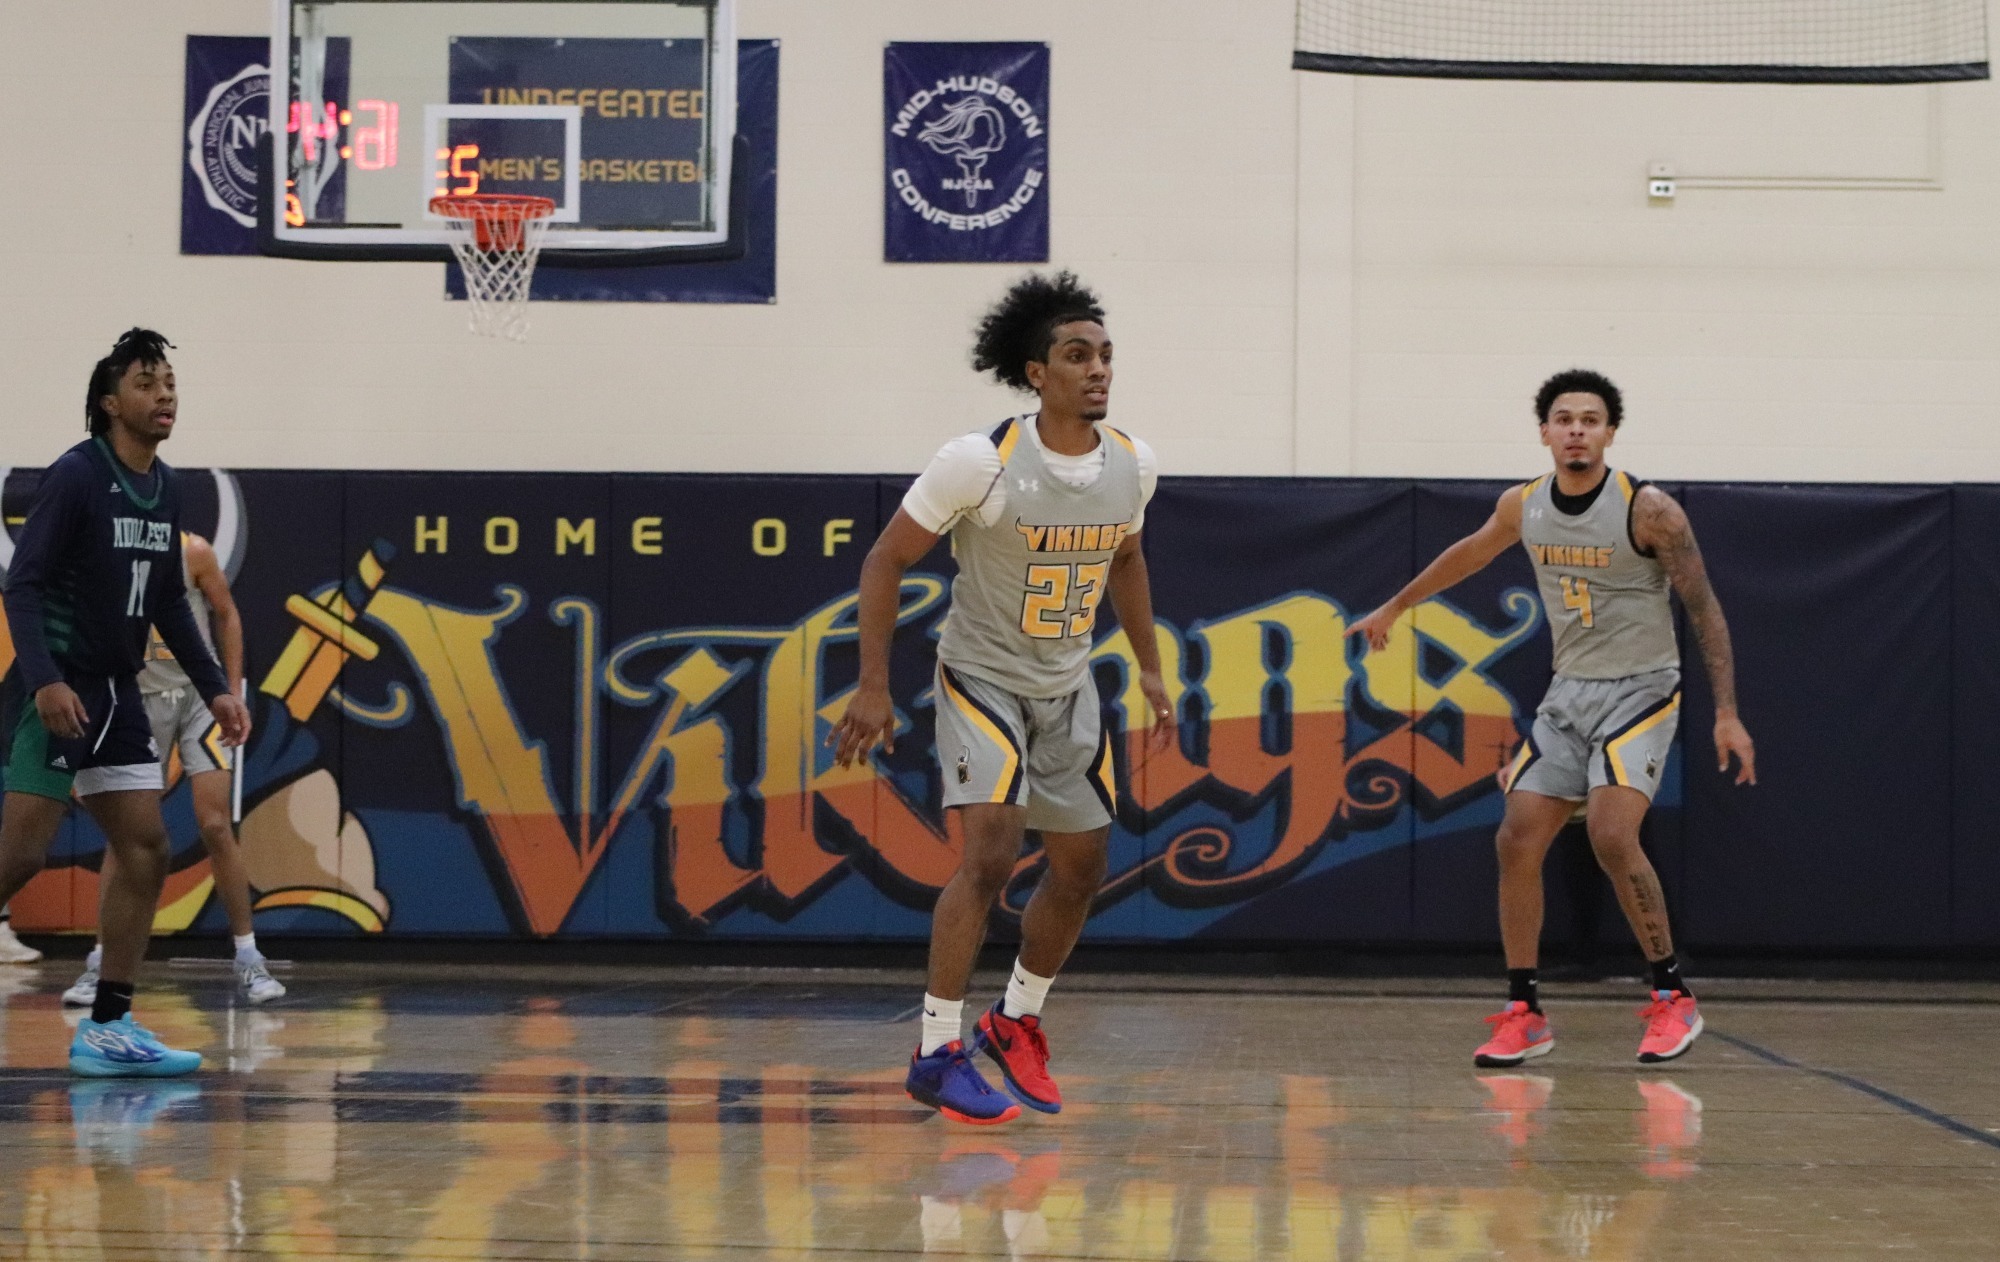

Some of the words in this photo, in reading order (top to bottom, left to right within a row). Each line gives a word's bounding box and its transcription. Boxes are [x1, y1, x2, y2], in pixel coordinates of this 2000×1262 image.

[891, 75, 1044, 139] MID-HUDSON
[479, 156, 561, 183] MEN'S
[891, 167, 1044, 231] CONFERENCE
[414, 516, 664, 556] HOME
[751, 518, 856, 557] OF
[1016, 518, 1132, 552] VIKINGS
[1021, 558, 1109, 639] 23
[1558, 573, 1595, 629] 4
[335, 576, 1542, 940] Vikngs
